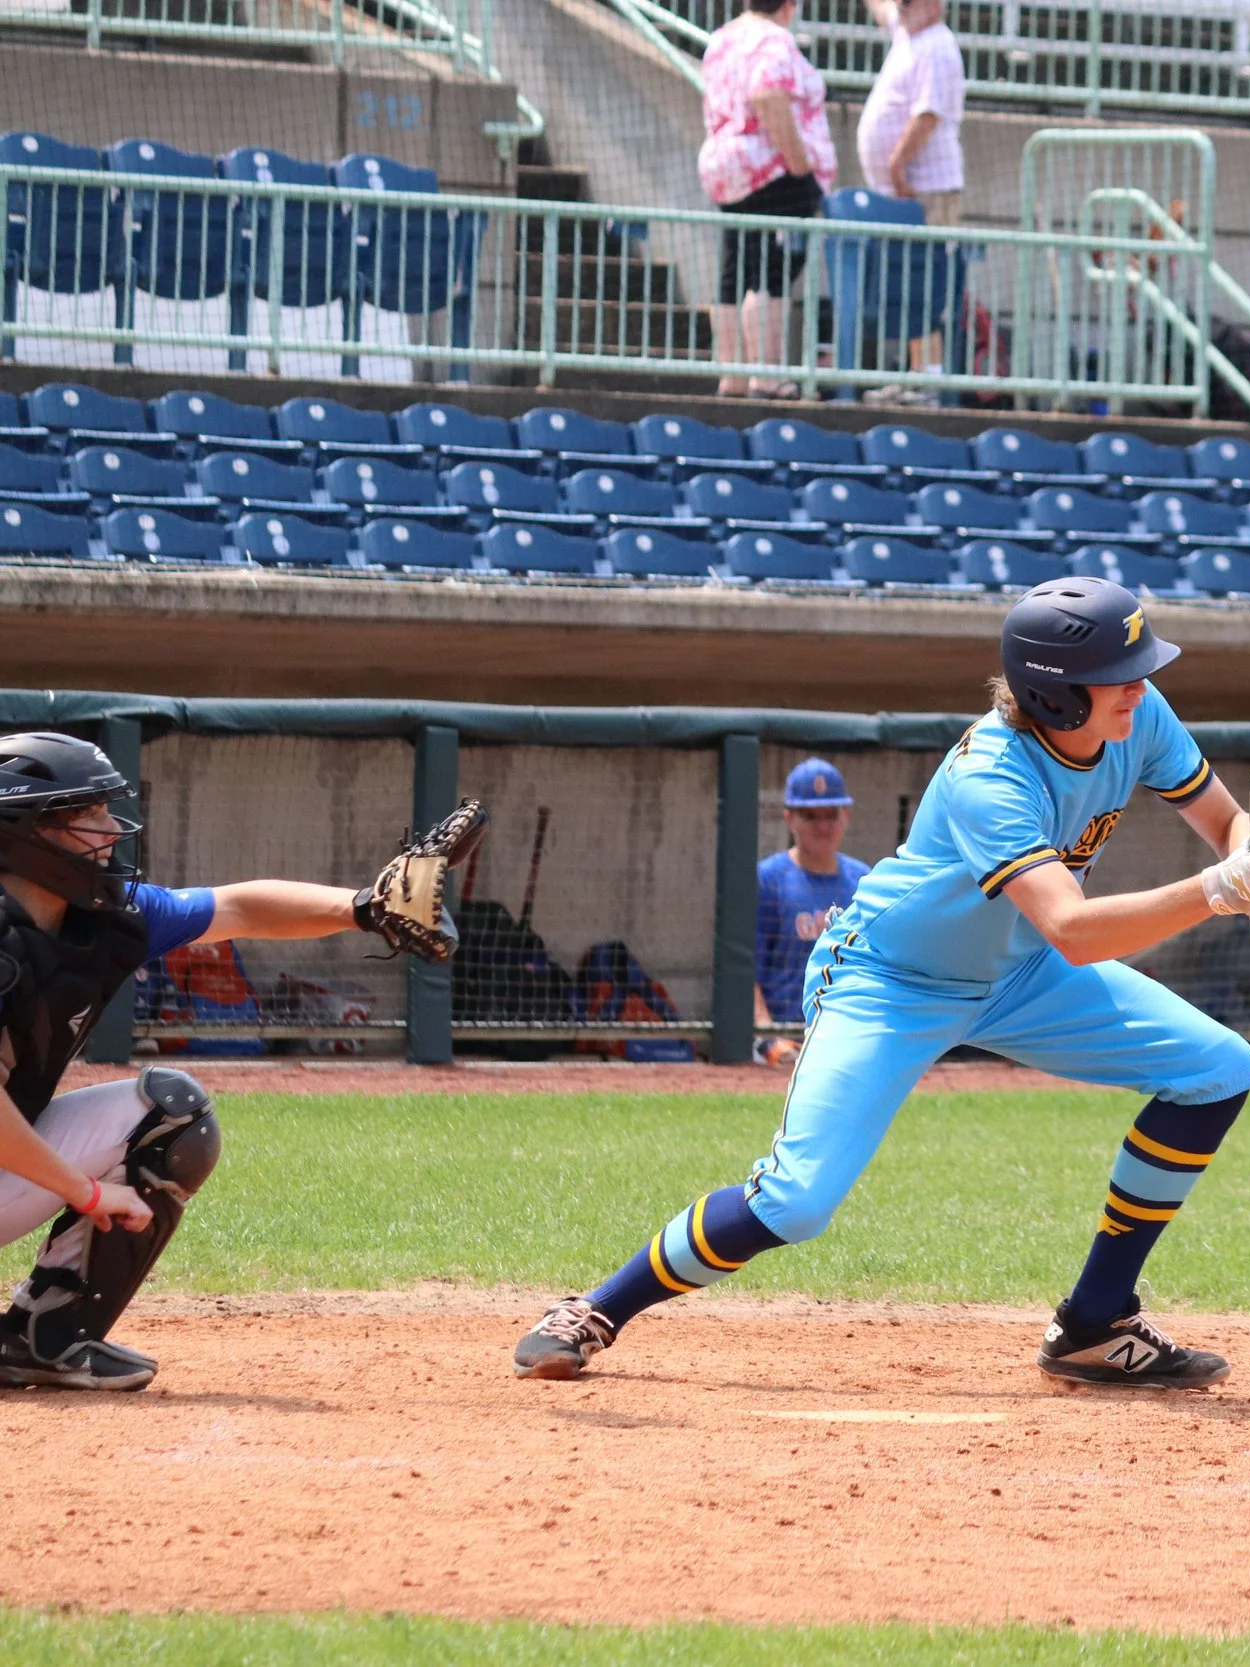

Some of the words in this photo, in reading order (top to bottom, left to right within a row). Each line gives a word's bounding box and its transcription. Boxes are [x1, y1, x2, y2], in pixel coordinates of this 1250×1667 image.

[356, 90, 423, 129] 212
[1123, 606, 1145, 647] F
[1104, 1340, 1154, 1374] N
